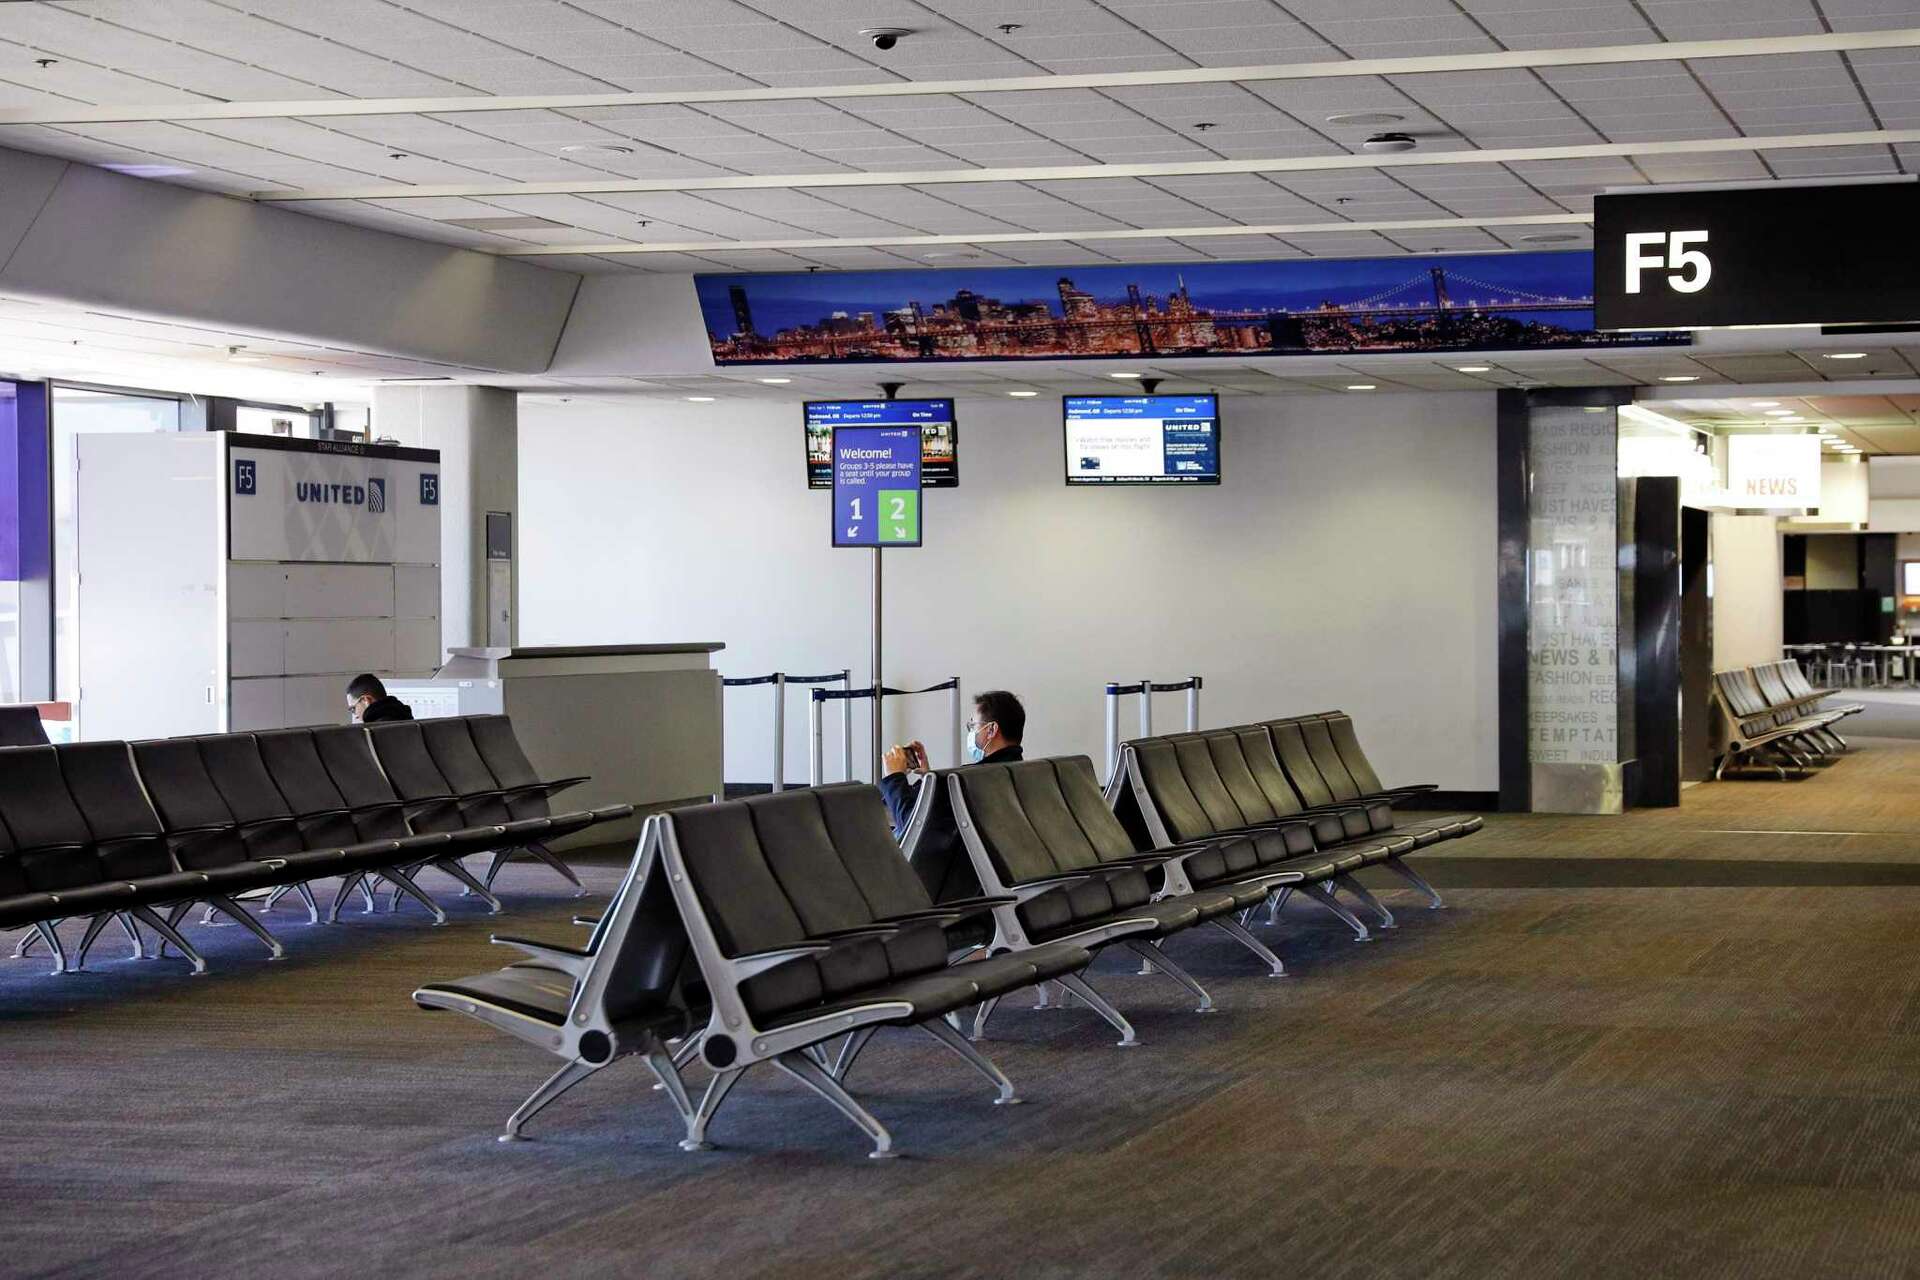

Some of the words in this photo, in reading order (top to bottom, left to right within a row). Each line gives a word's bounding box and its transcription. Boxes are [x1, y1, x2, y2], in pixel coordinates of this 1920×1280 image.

[1625, 230, 1712, 294] F5
[840, 448, 892, 459] Welcome!
[840, 462, 862, 471] Groups
[864, 462, 875, 470] 3-5
[876, 462, 896, 471] please
[897, 461, 914, 470] have
[875, 471, 890, 479] your
[891, 470, 911, 478] group
[239, 465, 253, 489] F5
[1747, 478, 1797, 495] NEWS
[296, 482, 365, 505] UNITED
[423, 479, 436, 500] F5
[850, 497, 863, 520] 1
[890, 497, 905, 520] 2
[1529, 649, 1580, 666] NEWS
[1588, 649, 1600, 665] &
[1528, 670, 1592, 685] FASHION
